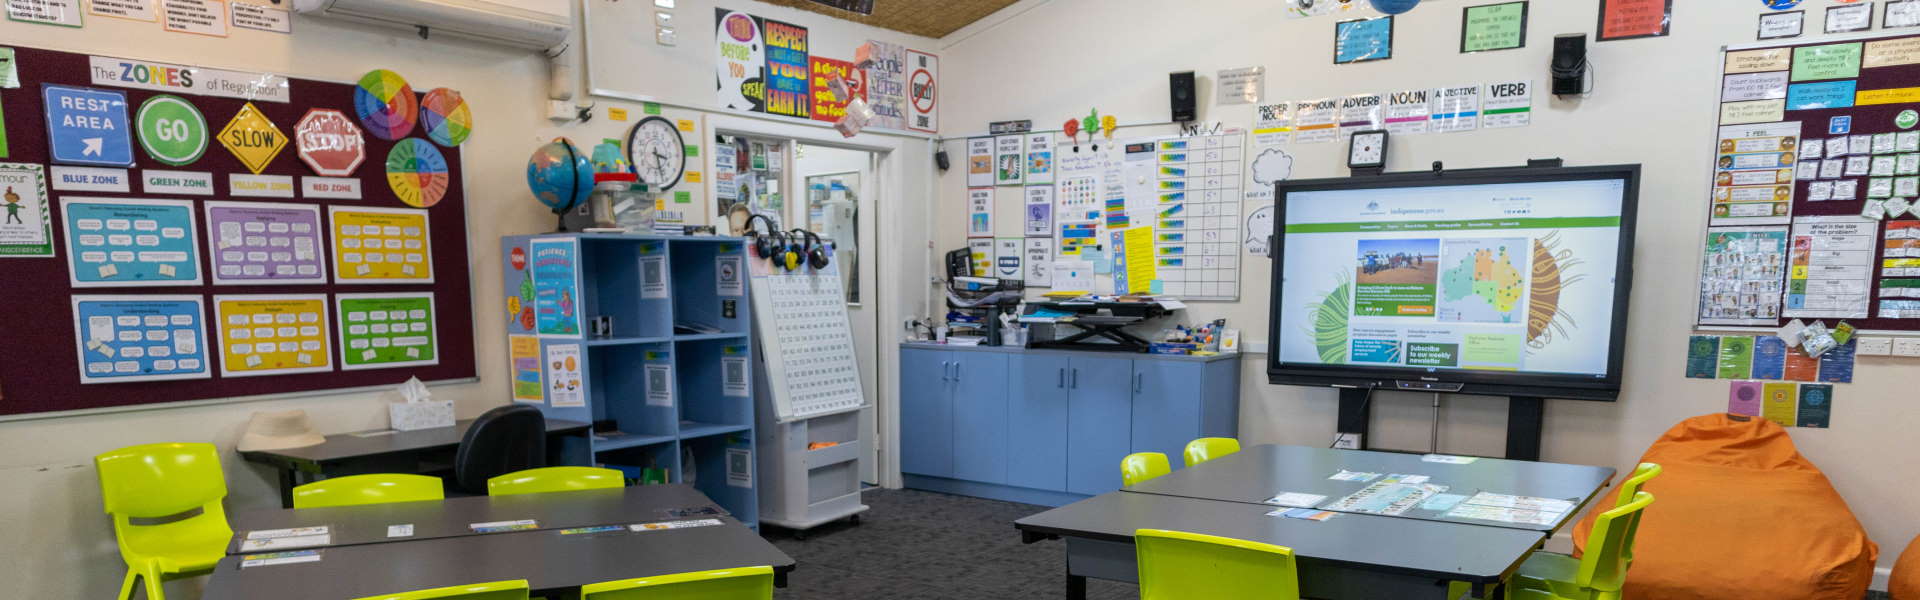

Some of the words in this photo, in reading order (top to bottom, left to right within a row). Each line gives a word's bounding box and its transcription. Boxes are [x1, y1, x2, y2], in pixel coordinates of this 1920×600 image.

[766, 21, 808, 52] RESPECT
[92, 65, 116, 80] The
[120, 62, 193, 88] ZONES
[769, 61, 806, 80] YOU
[206, 78, 219, 90] of
[221, 80, 278, 96] Regultion
[1435, 86, 1477, 98] AJECTIVE
[1491, 82, 1526, 98] VERB
[60, 96, 110, 113] REST
[767, 89, 795, 116] EARN
[1343, 96, 1380, 108] ADVERB
[1390, 90, 1427, 105] NOUN
[1259, 104, 1288, 113] PROPER
[1297, 100, 1336, 112] PRONOUN
[63, 114, 114, 130] AREA
[1262, 112, 1285, 120] NOU
[156, 118, 189, 142] GO
[232, 130, 276, 150] SLOW
[63, 174, 90, 184] BLUE
[92, 174, 118, 185] ZONE
[150, 177, 182, 188] GREEN
[184, 178, 208, 188] ZONE
[232, 180, 268, 191] YELLOW
[313, 184, 330, 192] RED
[331, 184, 352, 193] ZONE
